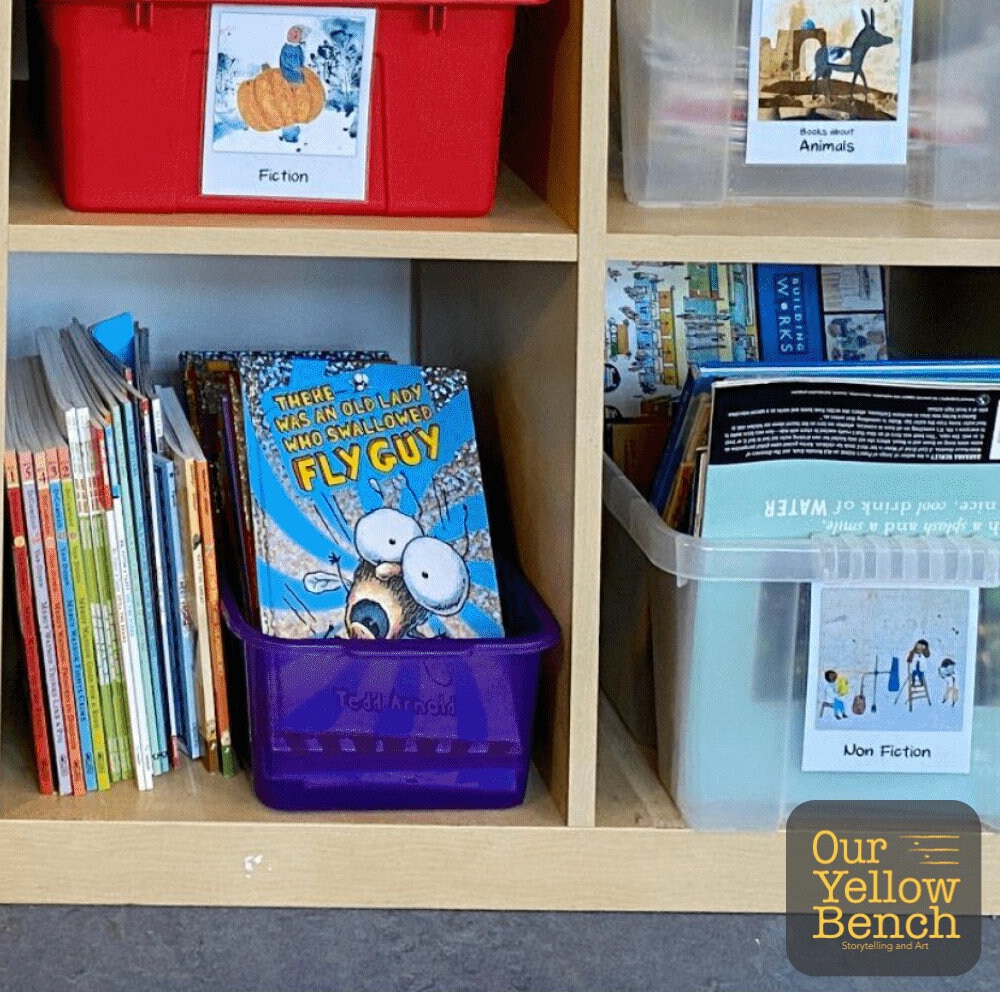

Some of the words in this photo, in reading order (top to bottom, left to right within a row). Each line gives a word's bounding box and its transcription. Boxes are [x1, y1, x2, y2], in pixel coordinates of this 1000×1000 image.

[799, 128, 828, 136] Books
[799, 139, 855, 153] Animals
[258, 168, 309, 183] Fiction
[273, 385, 336, 411] THERE
[274, 410, 311, 433] WAS
[314, 405, 338, 425] AN
[340, 396, 376, 417] OLD
[378, 383, 424, 409] LADY
[282, 430, 324, 453] WHO
[326, 405, 433, 443] SWALLOWED
[292, 443, 362, 492] FLY
[366, 423, 441, 474] GUY
[764, 498, 828, 517] WATER
[831, 500, 855, 516] of
[861, 500, 912, 516] drink
[916, 501, 947, 516] cool
[869, 521, 879, 531] a
[883, 521, 918, 536] and
[923, 517, 967, 536] splash
[843, 743, 874, 757] Non
[880, 745, 931, 758] Fiction
